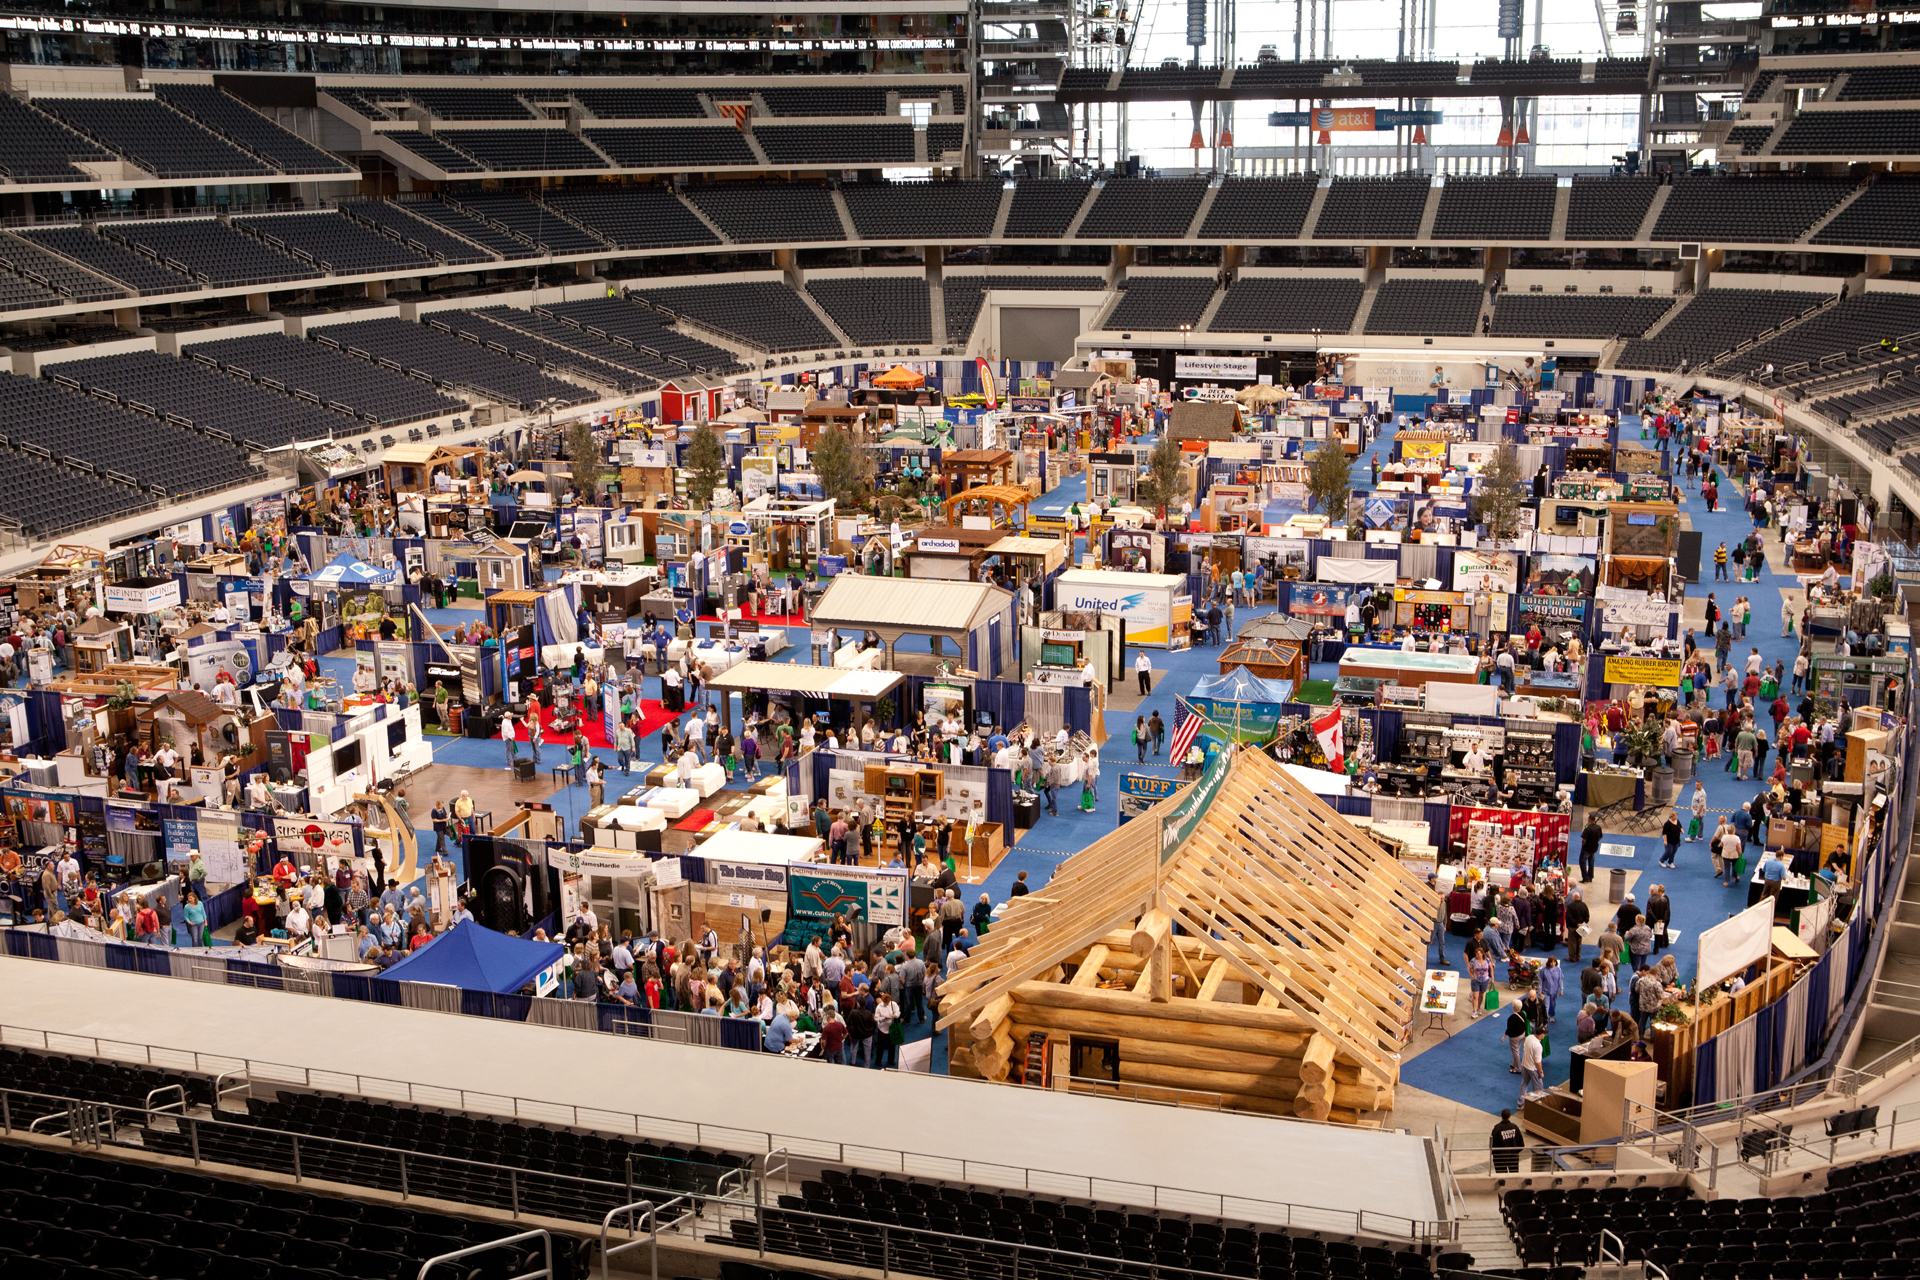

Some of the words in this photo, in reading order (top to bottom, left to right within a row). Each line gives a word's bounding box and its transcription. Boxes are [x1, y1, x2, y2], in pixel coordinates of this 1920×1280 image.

[1338, 111, 1369, 126] at&t
[1184, 361, 1222, 371] Lifestyle
[1223, 362, 1248, 371] Stage
[921, 539, 956, 549] archadeck
[107, 588, 144, 598] INFINITY
[147, 582, 178, 597] INFINITY
[1075, 596, 1118, 611] United
[1607, 658, 1634, 667] AMAZING
[1634, 659, 1657, 667] RUBBER
[1657, 660, 1679, 669] BROOM
[1127, 777, 1171, 793] TUFF
[176, 823, 195, 832] Flexible
[167, 830, 185, 838] Builder
[580, 860, 621, 870] JamesHardie
[718, 865, 734, 877] The
[733, 866, 763, 881] Shower
[763, 869, 784, 884] Shop
[791, 867, 814, 877] Cutting
